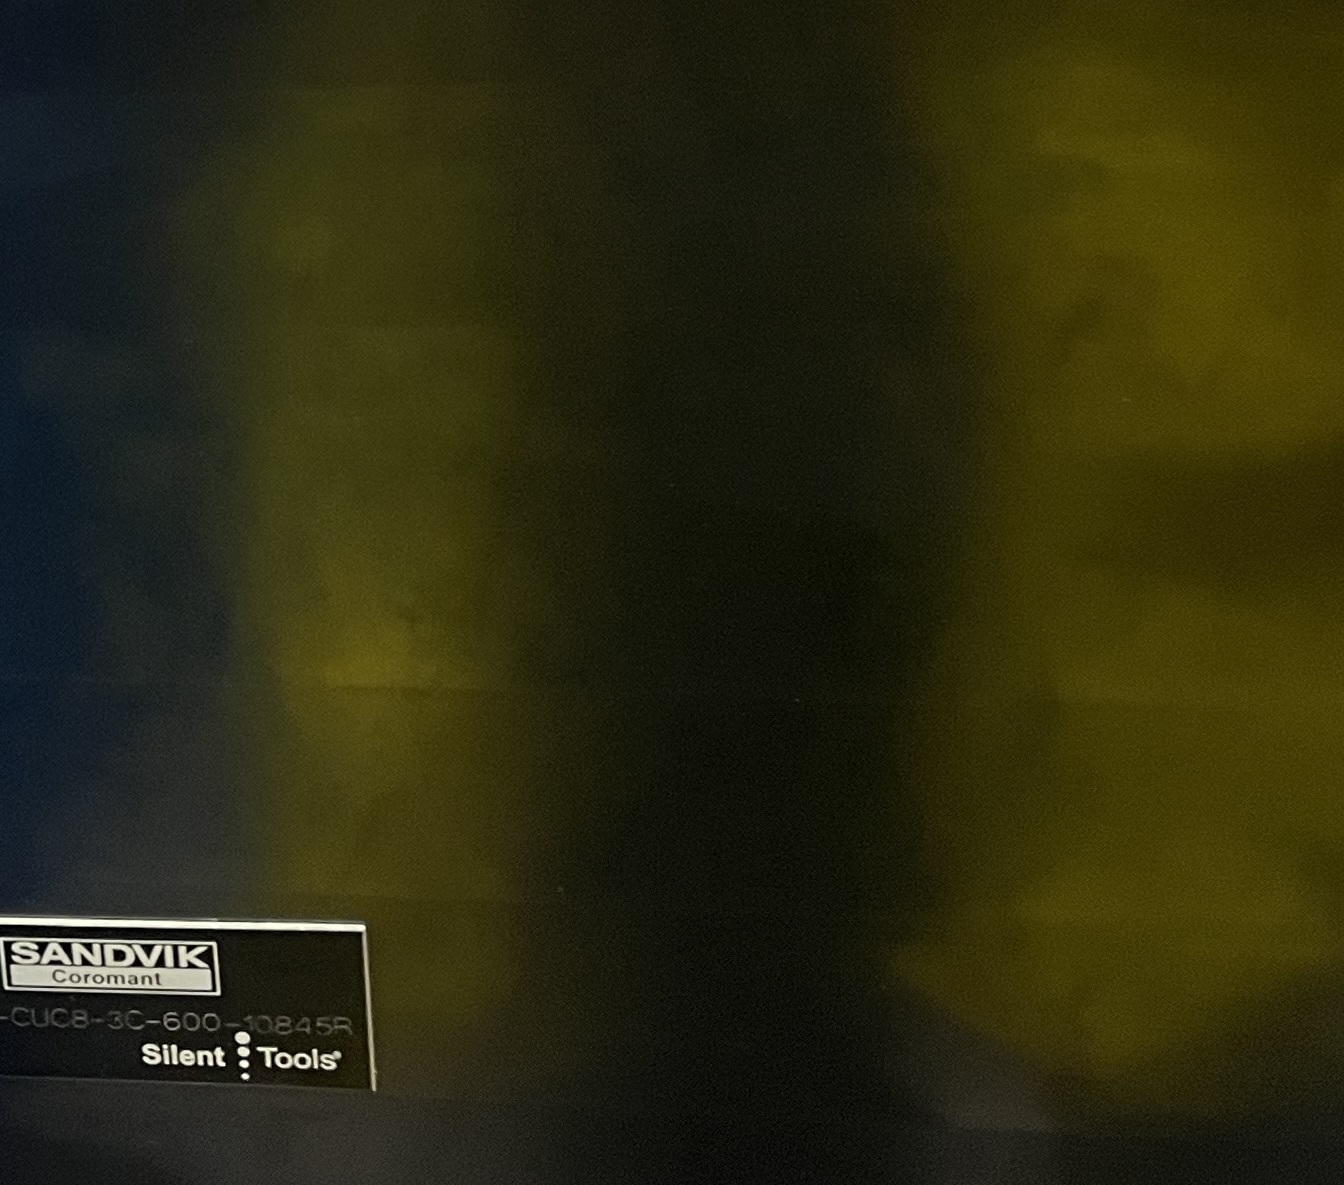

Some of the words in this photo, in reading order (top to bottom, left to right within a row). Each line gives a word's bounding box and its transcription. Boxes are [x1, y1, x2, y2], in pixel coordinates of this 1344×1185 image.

[10, 941, 211, 968] SANDVIK
[51, 968, 162, 987] Coromant
[141, 1042, 226, 1067] Silent
